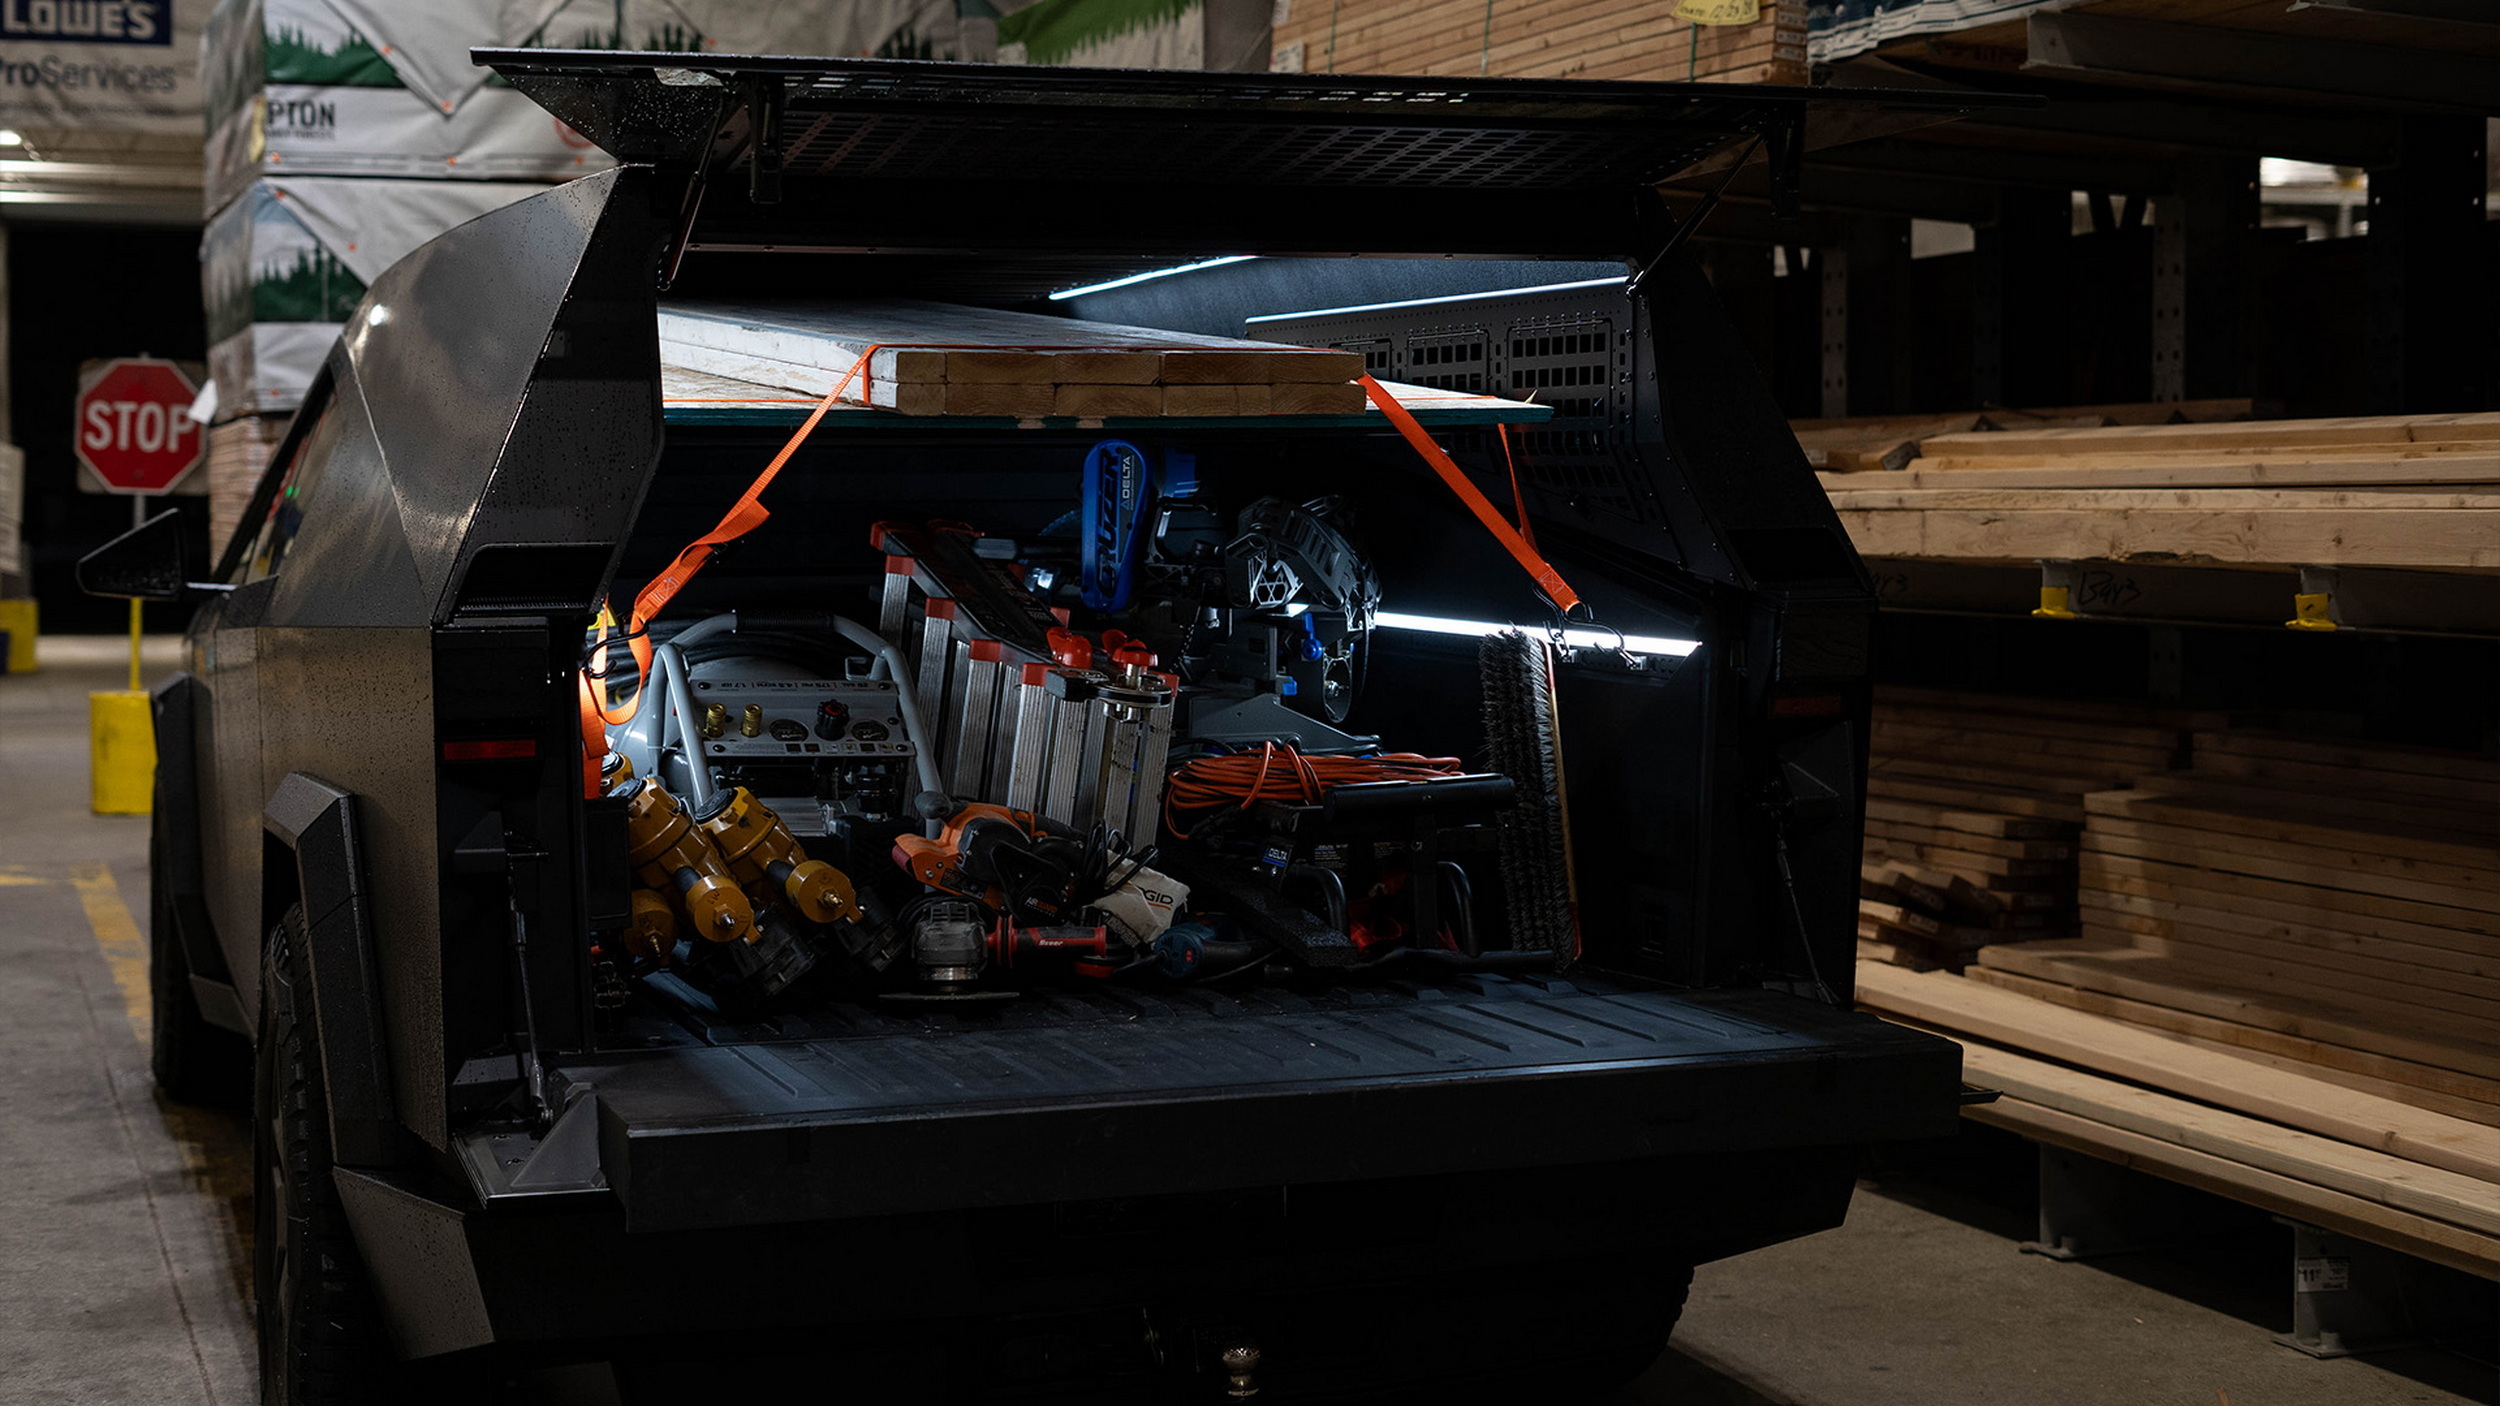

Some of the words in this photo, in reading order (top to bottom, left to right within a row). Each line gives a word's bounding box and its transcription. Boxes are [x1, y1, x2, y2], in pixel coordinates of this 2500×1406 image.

[0, 55, 175, 92] roServices
[83, 399, 198, 454] STOP
[1121, 456, 1131, 499] DELTA
[1266, 846, 1289, 861] DELTA
